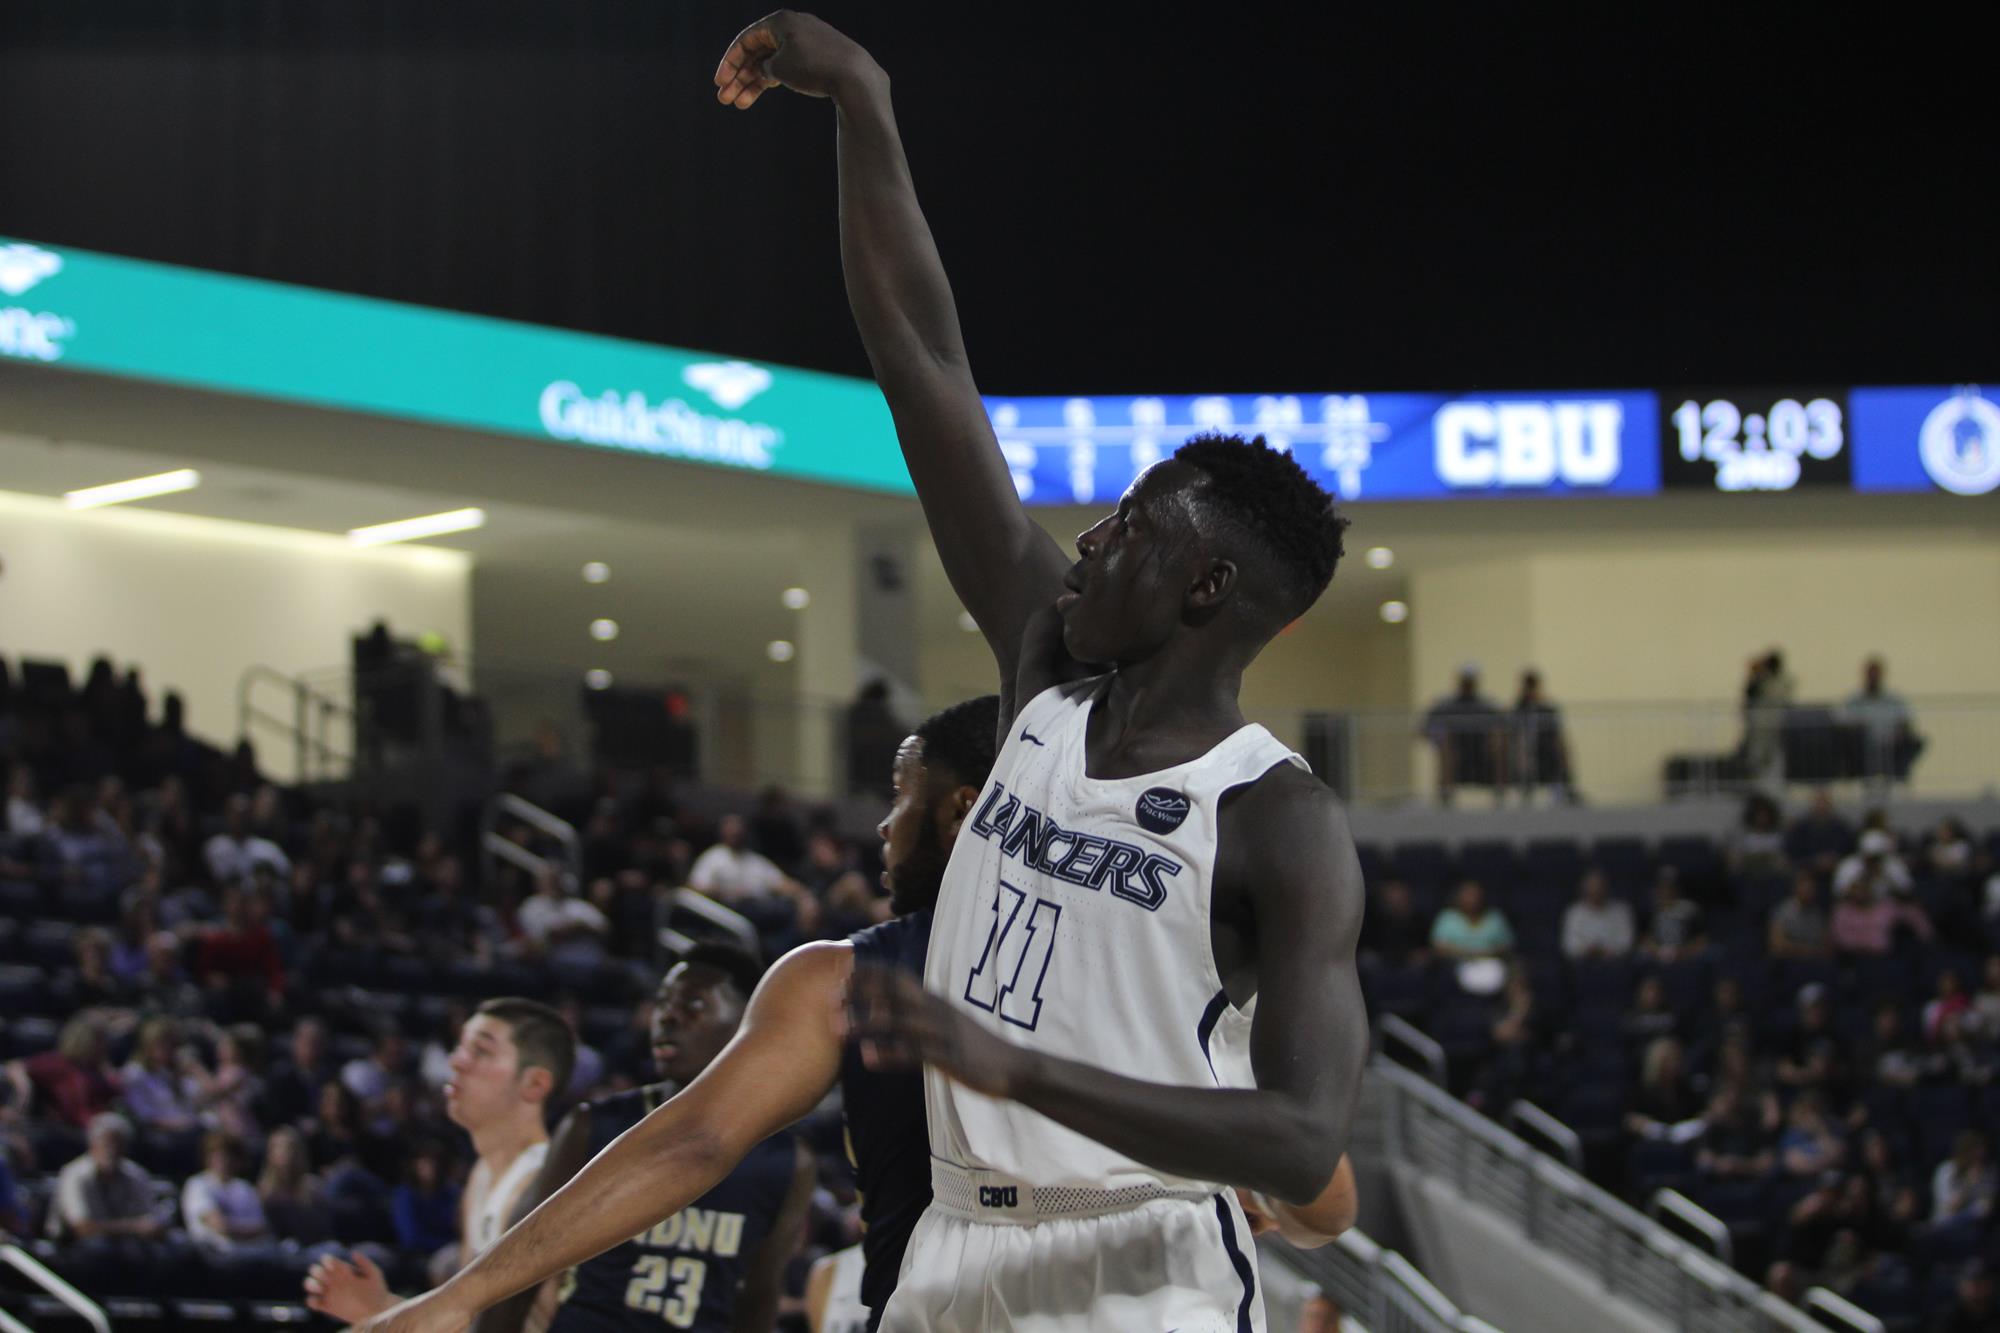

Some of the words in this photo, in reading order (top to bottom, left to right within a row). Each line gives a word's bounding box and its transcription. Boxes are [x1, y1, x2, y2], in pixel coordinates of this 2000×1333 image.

[1433, 401, 1622, 487] CBU
[1672, 398, 1844, 462] 12:03
[970, 781, 1182, 912] LANCERS
[964, 879, 1062, 1031] 11
[978, 1185, 1018, 1208] CBU
[624, 1254, 706, 1329] 23
